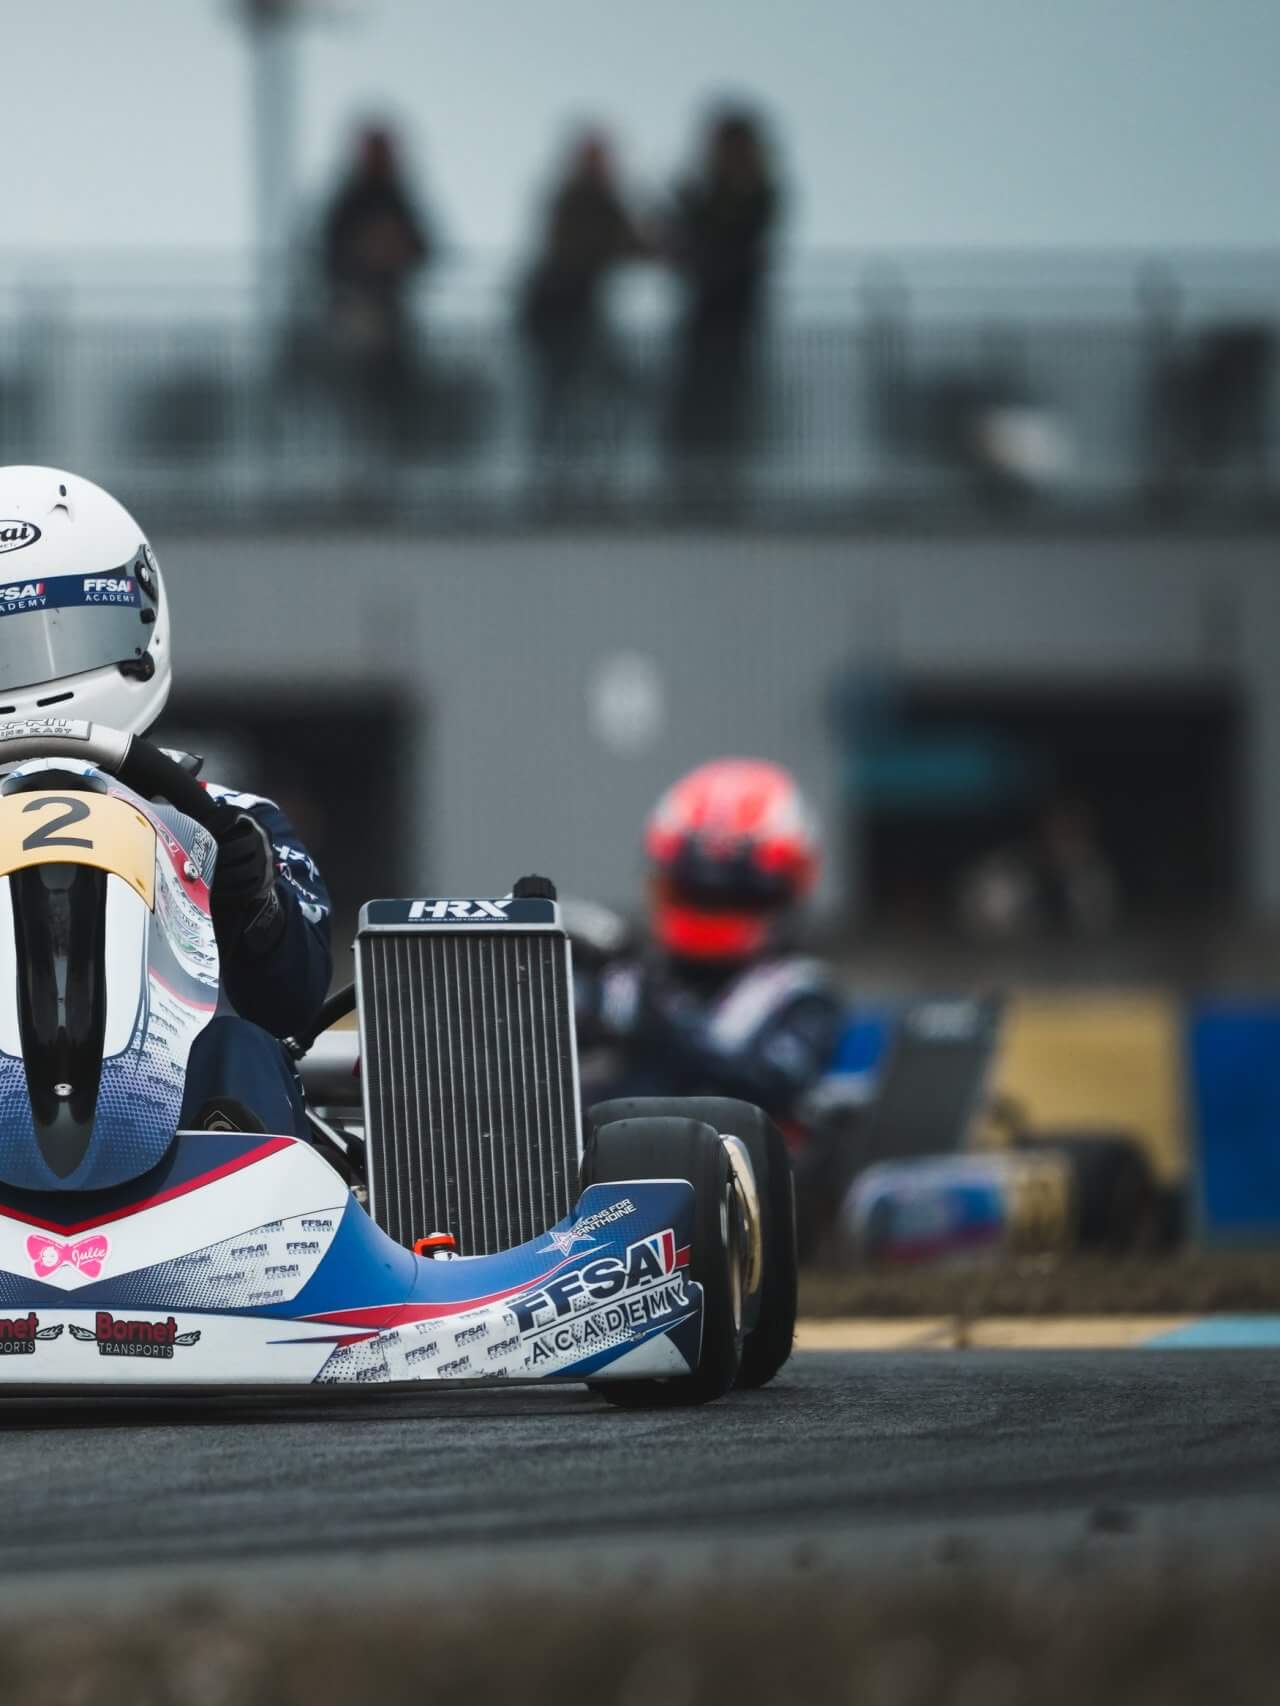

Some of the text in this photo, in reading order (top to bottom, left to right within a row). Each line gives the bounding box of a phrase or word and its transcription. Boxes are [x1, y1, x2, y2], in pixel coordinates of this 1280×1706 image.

[83, 578, 131, 593] FFSA
[85, 594, 135, 602] ACADEMY
[22, 796, 94, 852] 2
[408, 893, 513, 918] HRX
[301, 1219, 331, 1227] FFSA
[286, 1242, 317, 1250] FFSA
[72, 1247, 107, 1265] Julie
[265, 1264, 298, 1275] FFSA
[507, 1237, 667, 1334] FFSA
[96, 1312, 177, 1342] Bornet
[532, 1281, 688, 1364] ACADEMY
[454, 1323, 486, 1342] FFSA
[99, 1342, 173, 1357] TRANSPORTS
[405, 1342, 437, 1361] FFSA
[488, 1336, 519, 1355] FFSA
[437, 1356, 469, 1374] FFSA
